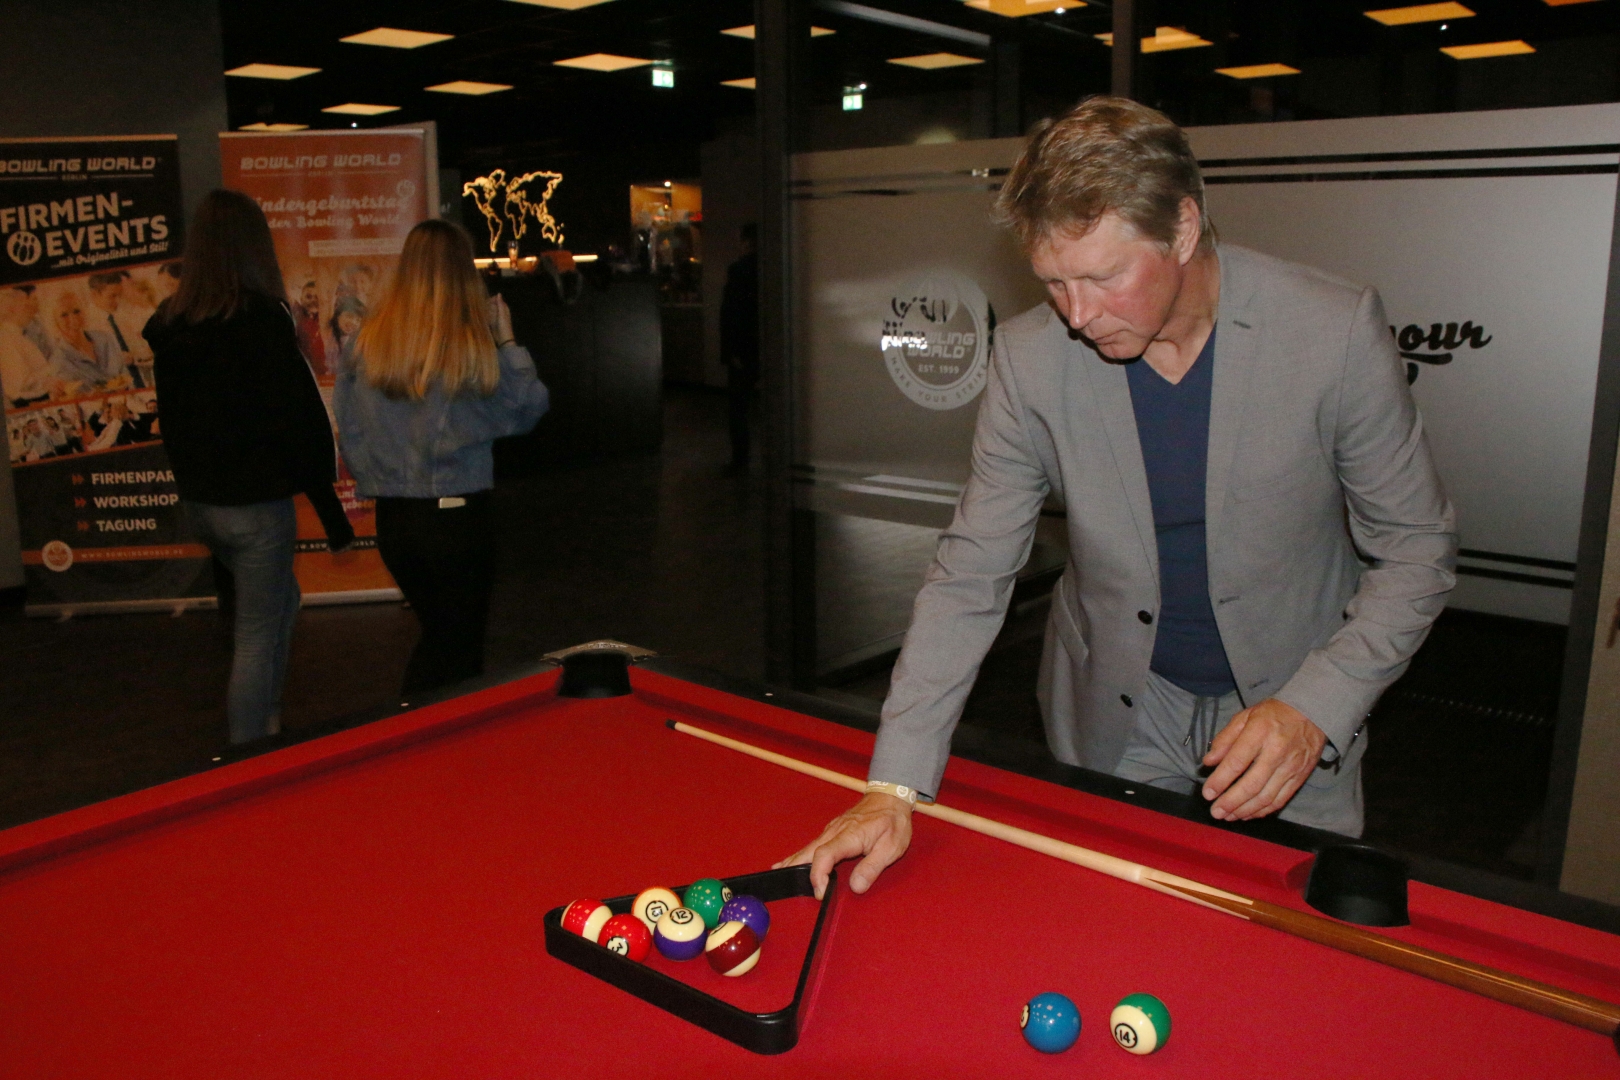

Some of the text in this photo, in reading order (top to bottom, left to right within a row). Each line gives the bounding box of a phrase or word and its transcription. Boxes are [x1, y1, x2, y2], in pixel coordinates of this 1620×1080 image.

[0, 157, 156, 173] BOWLING WORLD
[240, 153, 401, 170] BOWLING WORLD
[1, 192, 133, 233] FIRMEN-
[257, 195, 409, 216] indergeburtstag
[296, 214, 354, 232] Bowling
[357, 213, 401, 226] World
[45, 215, 169, 257] EVENTS
[1389, 320, 1493, 351] our
[91, 470, 175, 485] FIRMENPAR
[93, 493, 179, 508] WORKSHOP
[96, 518, 157, 532] TAGUNG
[676, 910, 688, 919] 12
[1119, 1029, 1131, 1044] 14
